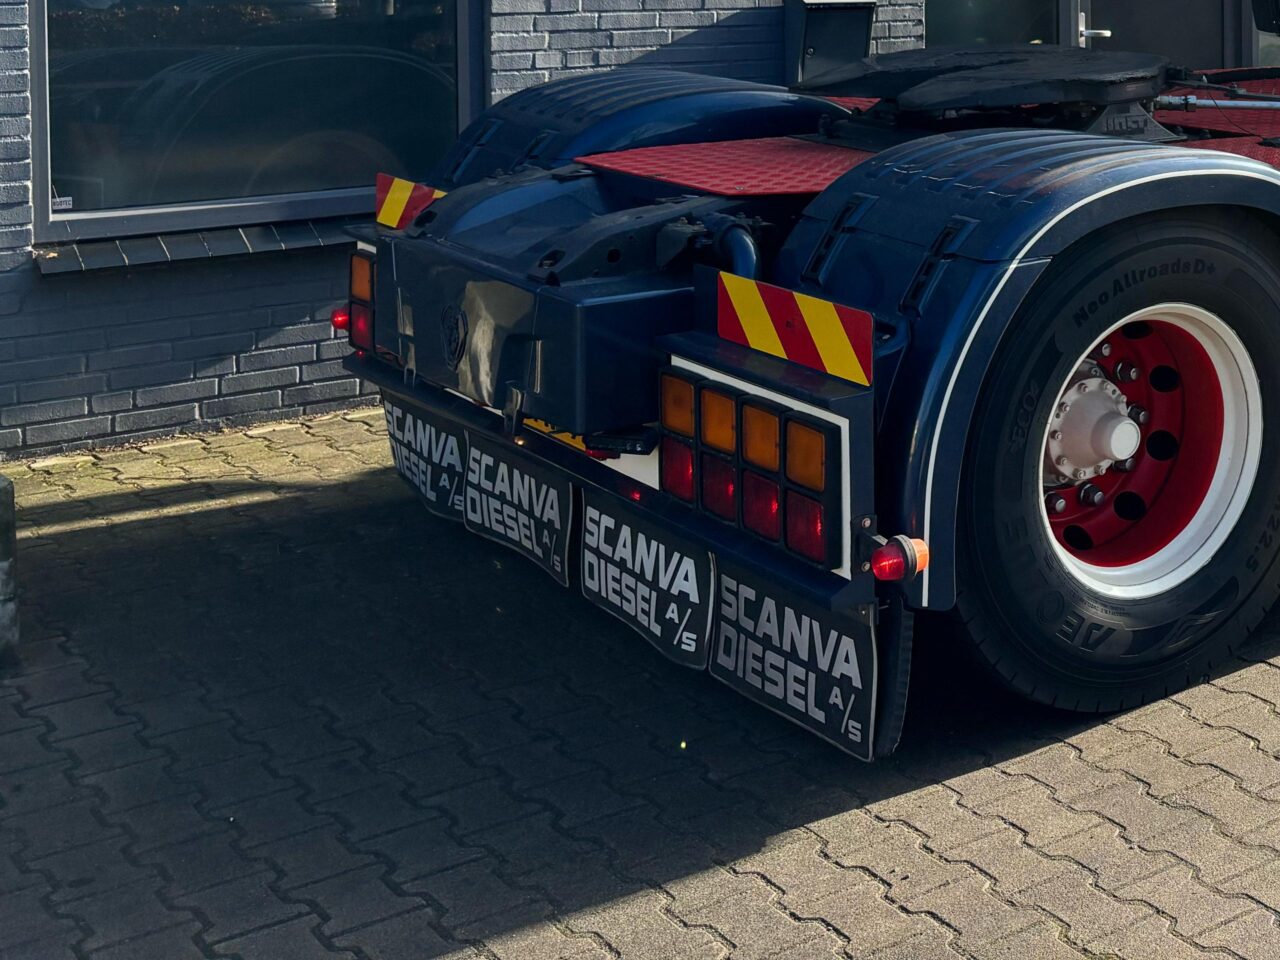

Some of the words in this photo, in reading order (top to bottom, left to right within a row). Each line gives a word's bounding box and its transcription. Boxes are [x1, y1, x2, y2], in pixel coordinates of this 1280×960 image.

[384, 400, 462, 472] SCANVA
[466, 485, 543, 559] DIESEL
[467, 446, 560, 530] SCANVA
[584, 549, 661, 637] DIESEL
[585, 506, 699, 604] SCANVA
[717, 621, 826, 724] DIESEL
[720, 574, 862, 689] SCANVA
